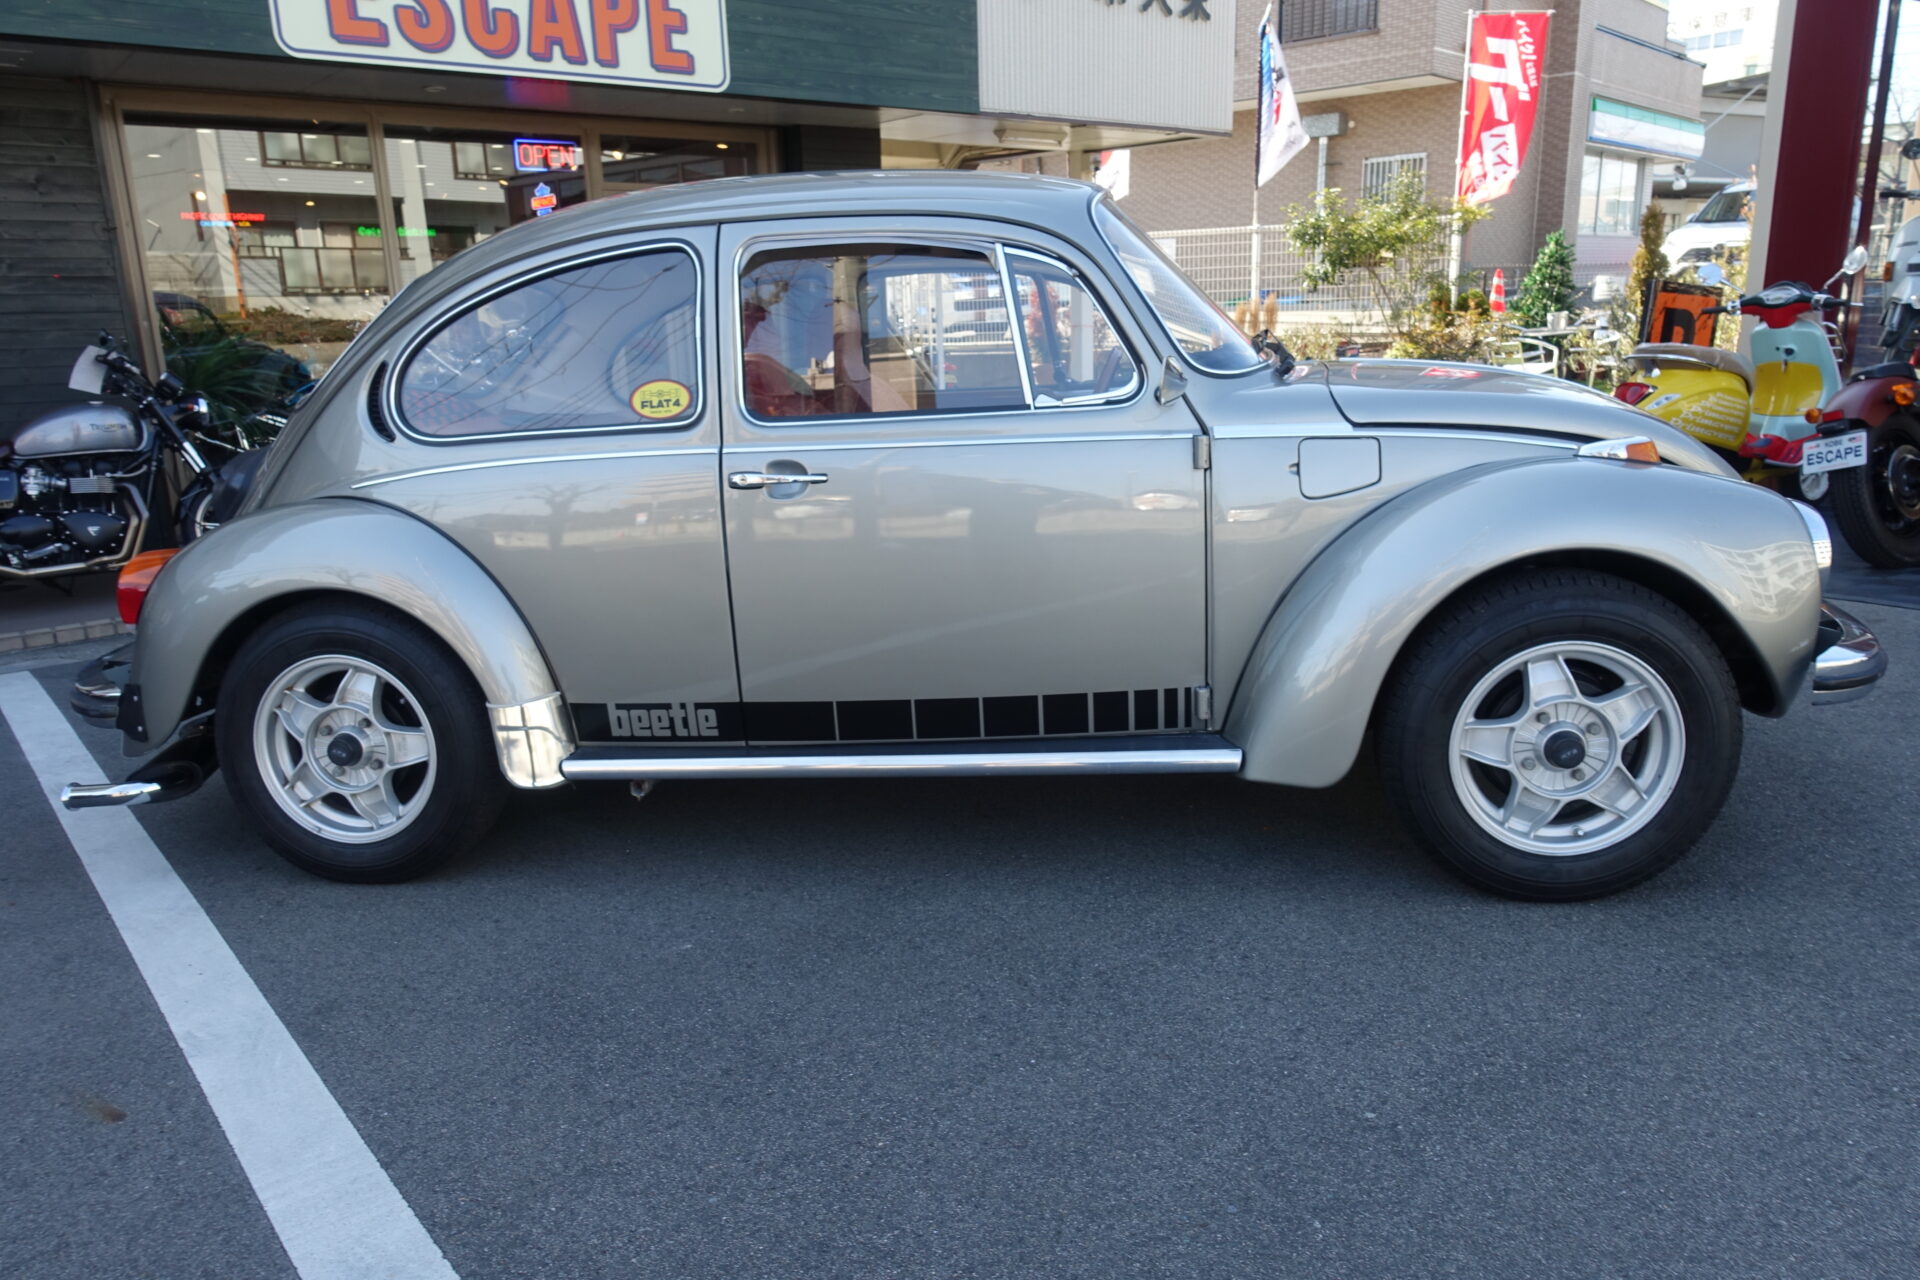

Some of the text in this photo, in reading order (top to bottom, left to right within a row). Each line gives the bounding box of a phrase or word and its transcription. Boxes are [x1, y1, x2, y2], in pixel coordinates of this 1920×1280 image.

[518, 143, 576, 167] OPEN
[1825, 439, 1843, 447] KOBE
[1807, 445, 1863, 466] ESCAPE
[607, 702, 719, 737] beetle
